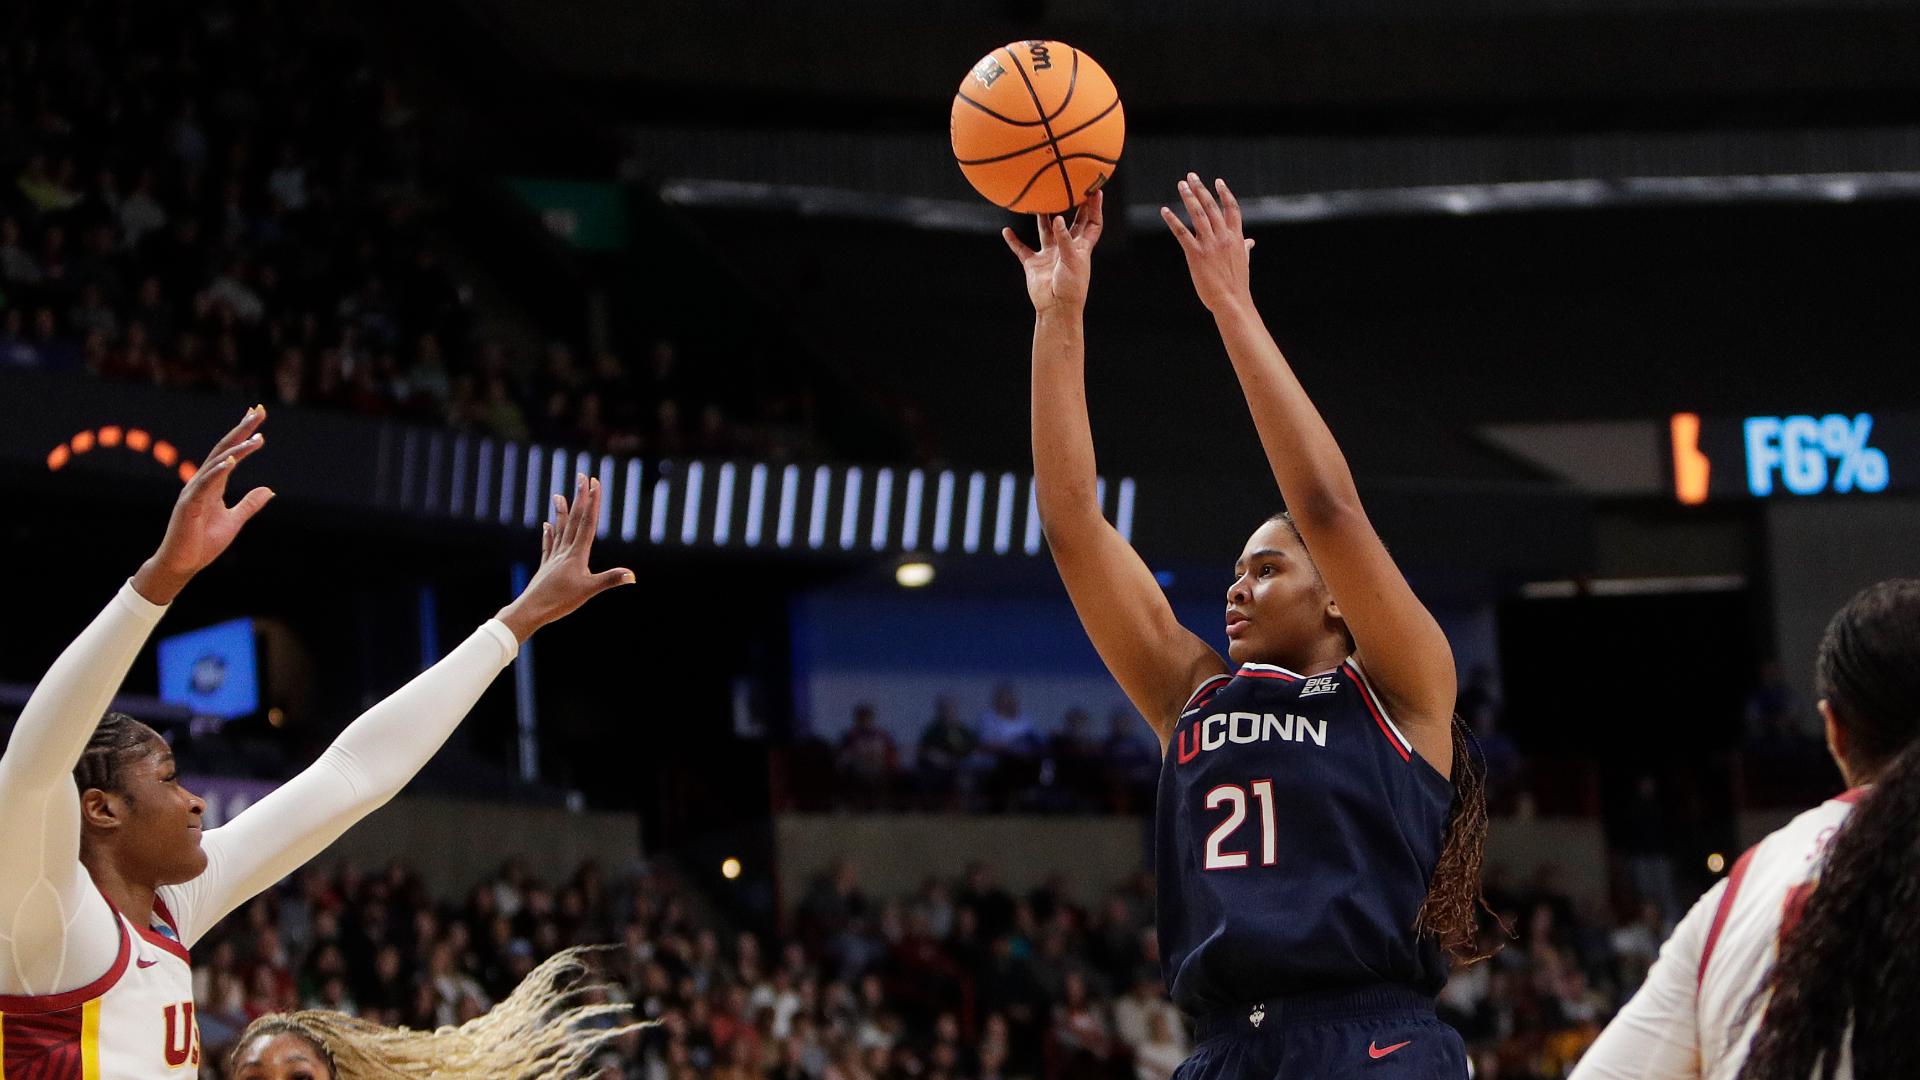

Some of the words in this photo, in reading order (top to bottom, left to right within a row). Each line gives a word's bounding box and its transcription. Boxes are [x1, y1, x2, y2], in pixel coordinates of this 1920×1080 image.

[1743, 413, 1890, 497] FG%
[1301, 683, 1341, 694] EAST
[1305, 676, 1334, 687] BIG
[1178, 712, 1328, 765] UCONN
[1203, 778, 1279, 871] 21
